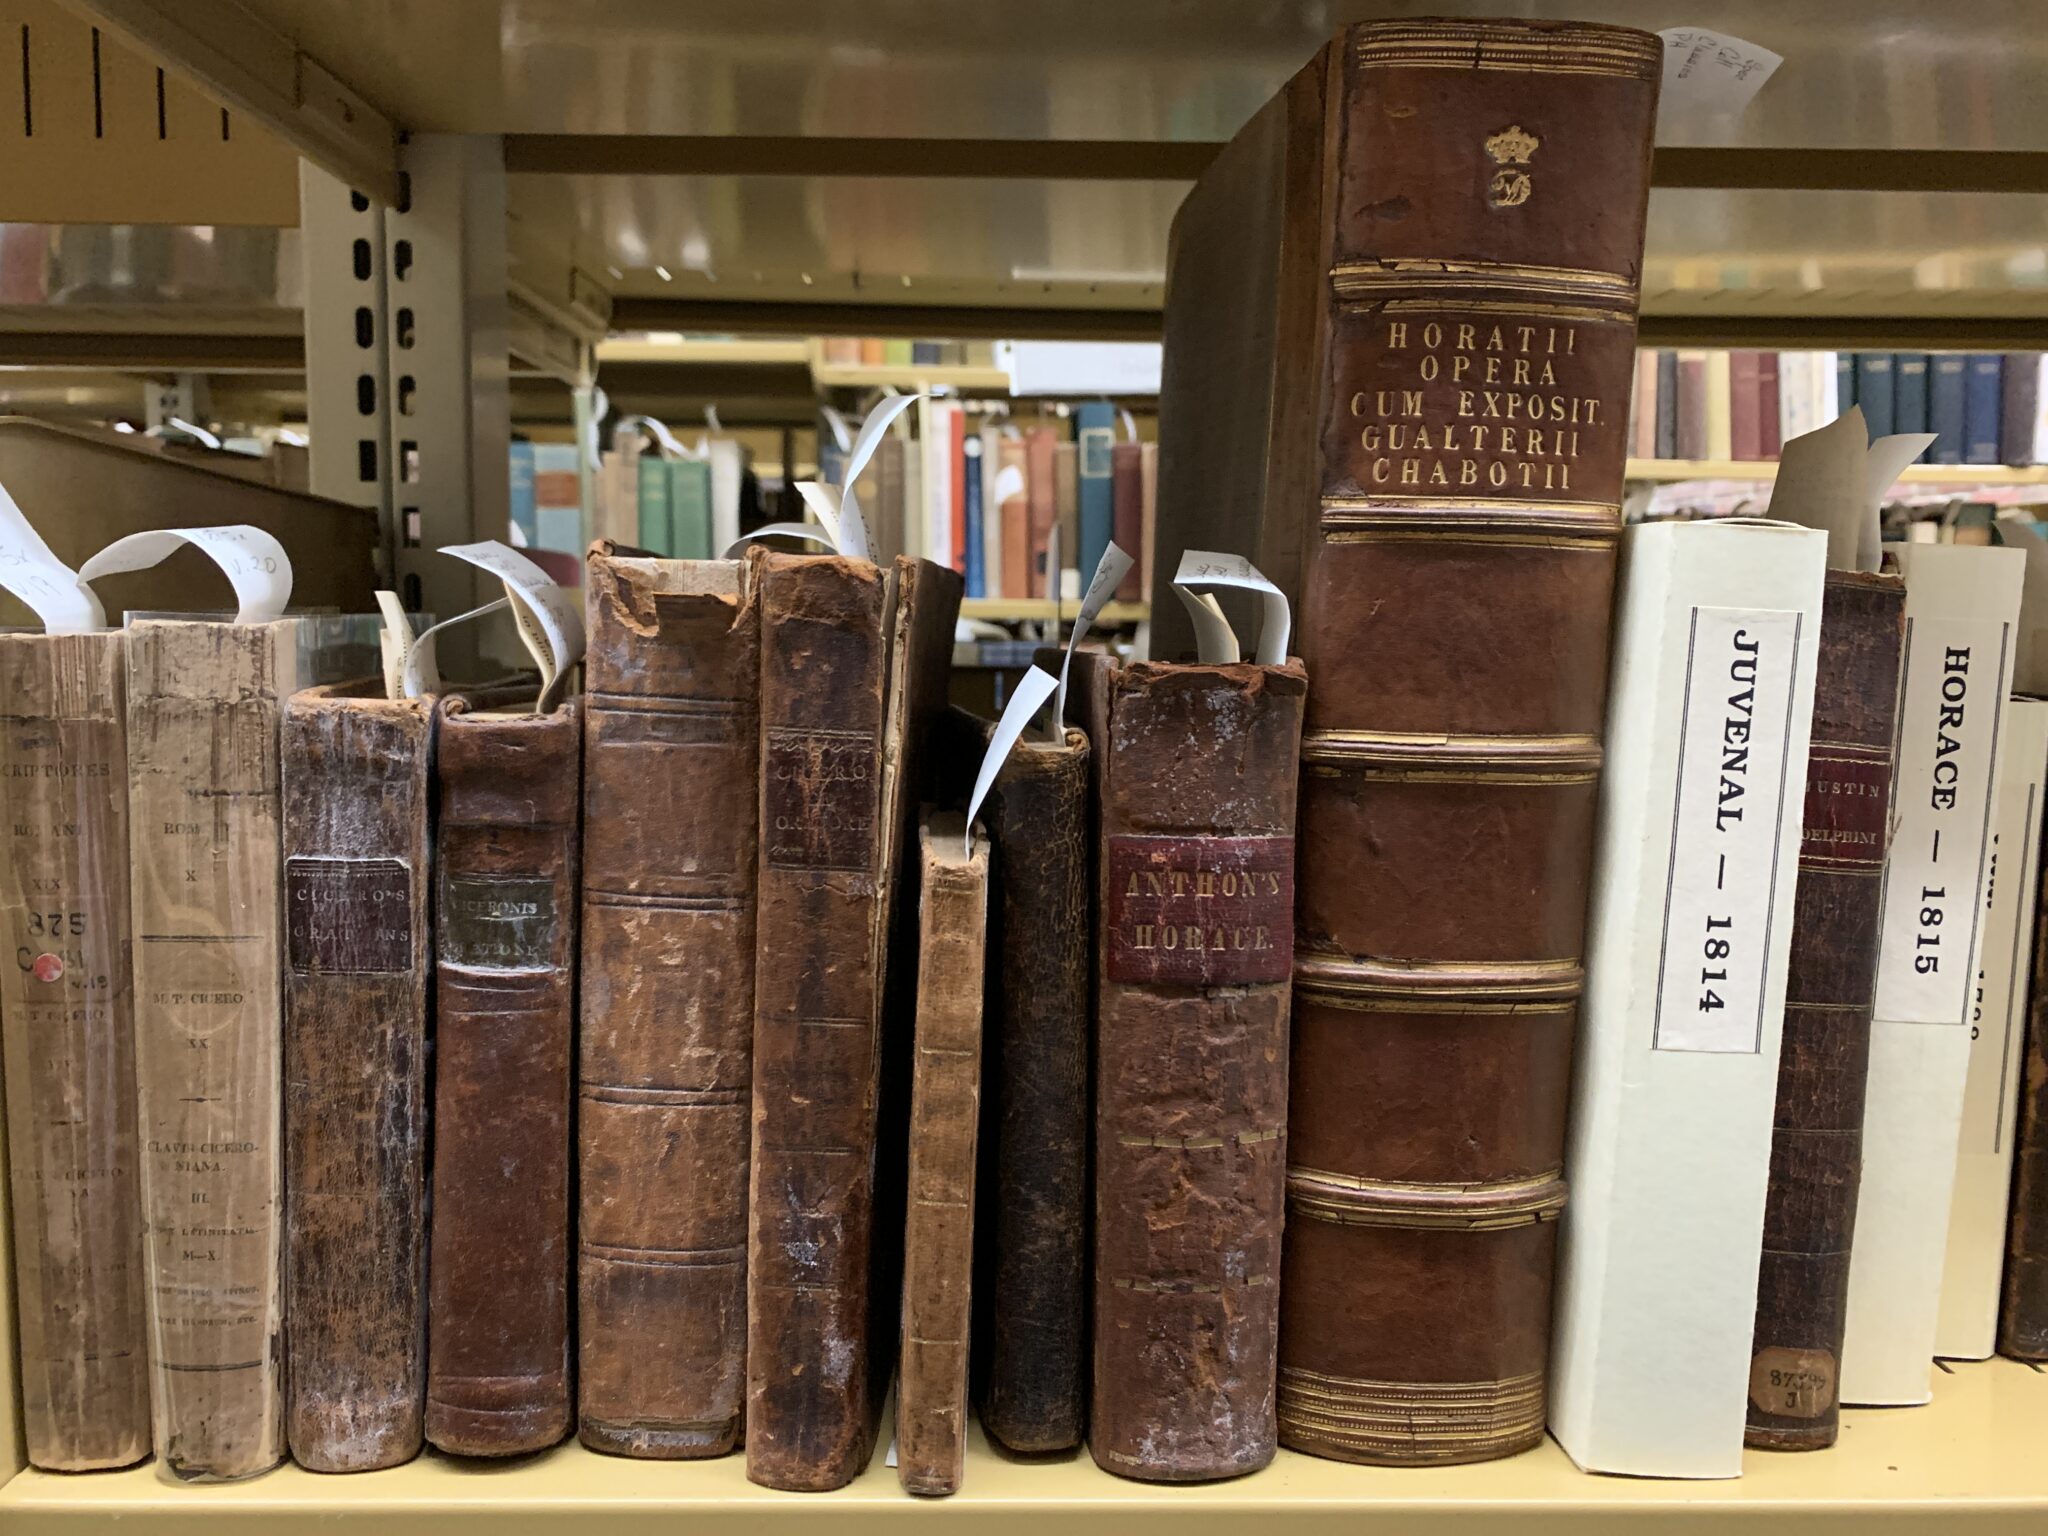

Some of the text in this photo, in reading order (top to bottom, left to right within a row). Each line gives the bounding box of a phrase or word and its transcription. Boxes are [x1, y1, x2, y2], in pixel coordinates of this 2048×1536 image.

[1388, 322, 1576, 355] HORATII
[1420, 355, 1557, 385] OPERA
[1350, 390, 1605, 426] CUM EXPOSIT.
[1361, 425, 1579, 457] GUALTERII
[1372, 457, 1570, 489] CHABOTII
[1714, 629, 1760, 833] JUVENAL
[1930, 645, 1972, 811] HORACE
[297, 888, 406, 902] CICRO'S
[1125, 870, 1282, 897] ANTHON'S
[27, 911, 88, 937] 875
[1134, 924, 1274, 951] HORACE.
[1914, 885, 1946, 975] 1815
[1698, 915, 1733, 1014] 1814
